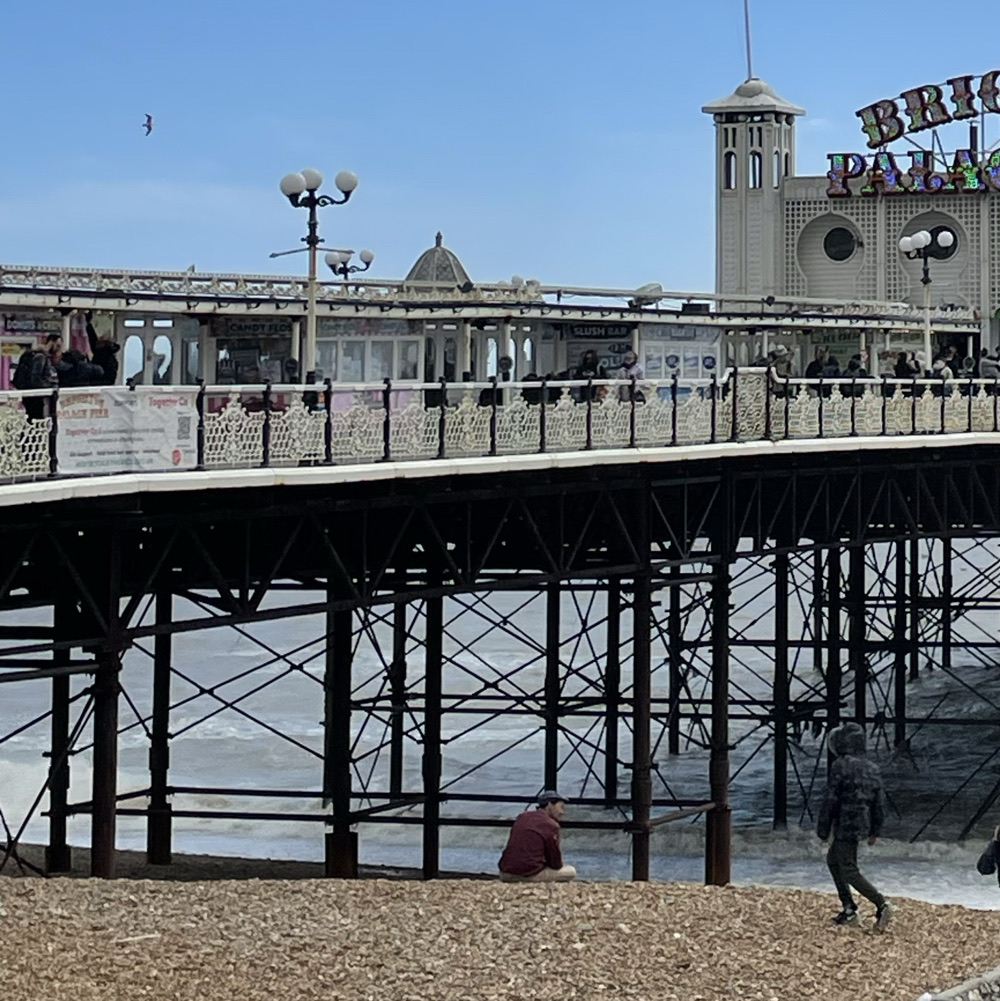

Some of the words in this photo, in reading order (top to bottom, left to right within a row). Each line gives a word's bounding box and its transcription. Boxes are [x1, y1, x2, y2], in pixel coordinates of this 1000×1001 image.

[230, 323, 266, 332] CANDY
[268, 323, 293, 332] FLOS
[573, 325, 605, 336] SLUSH
[607, 326, 628, 336] BAR
